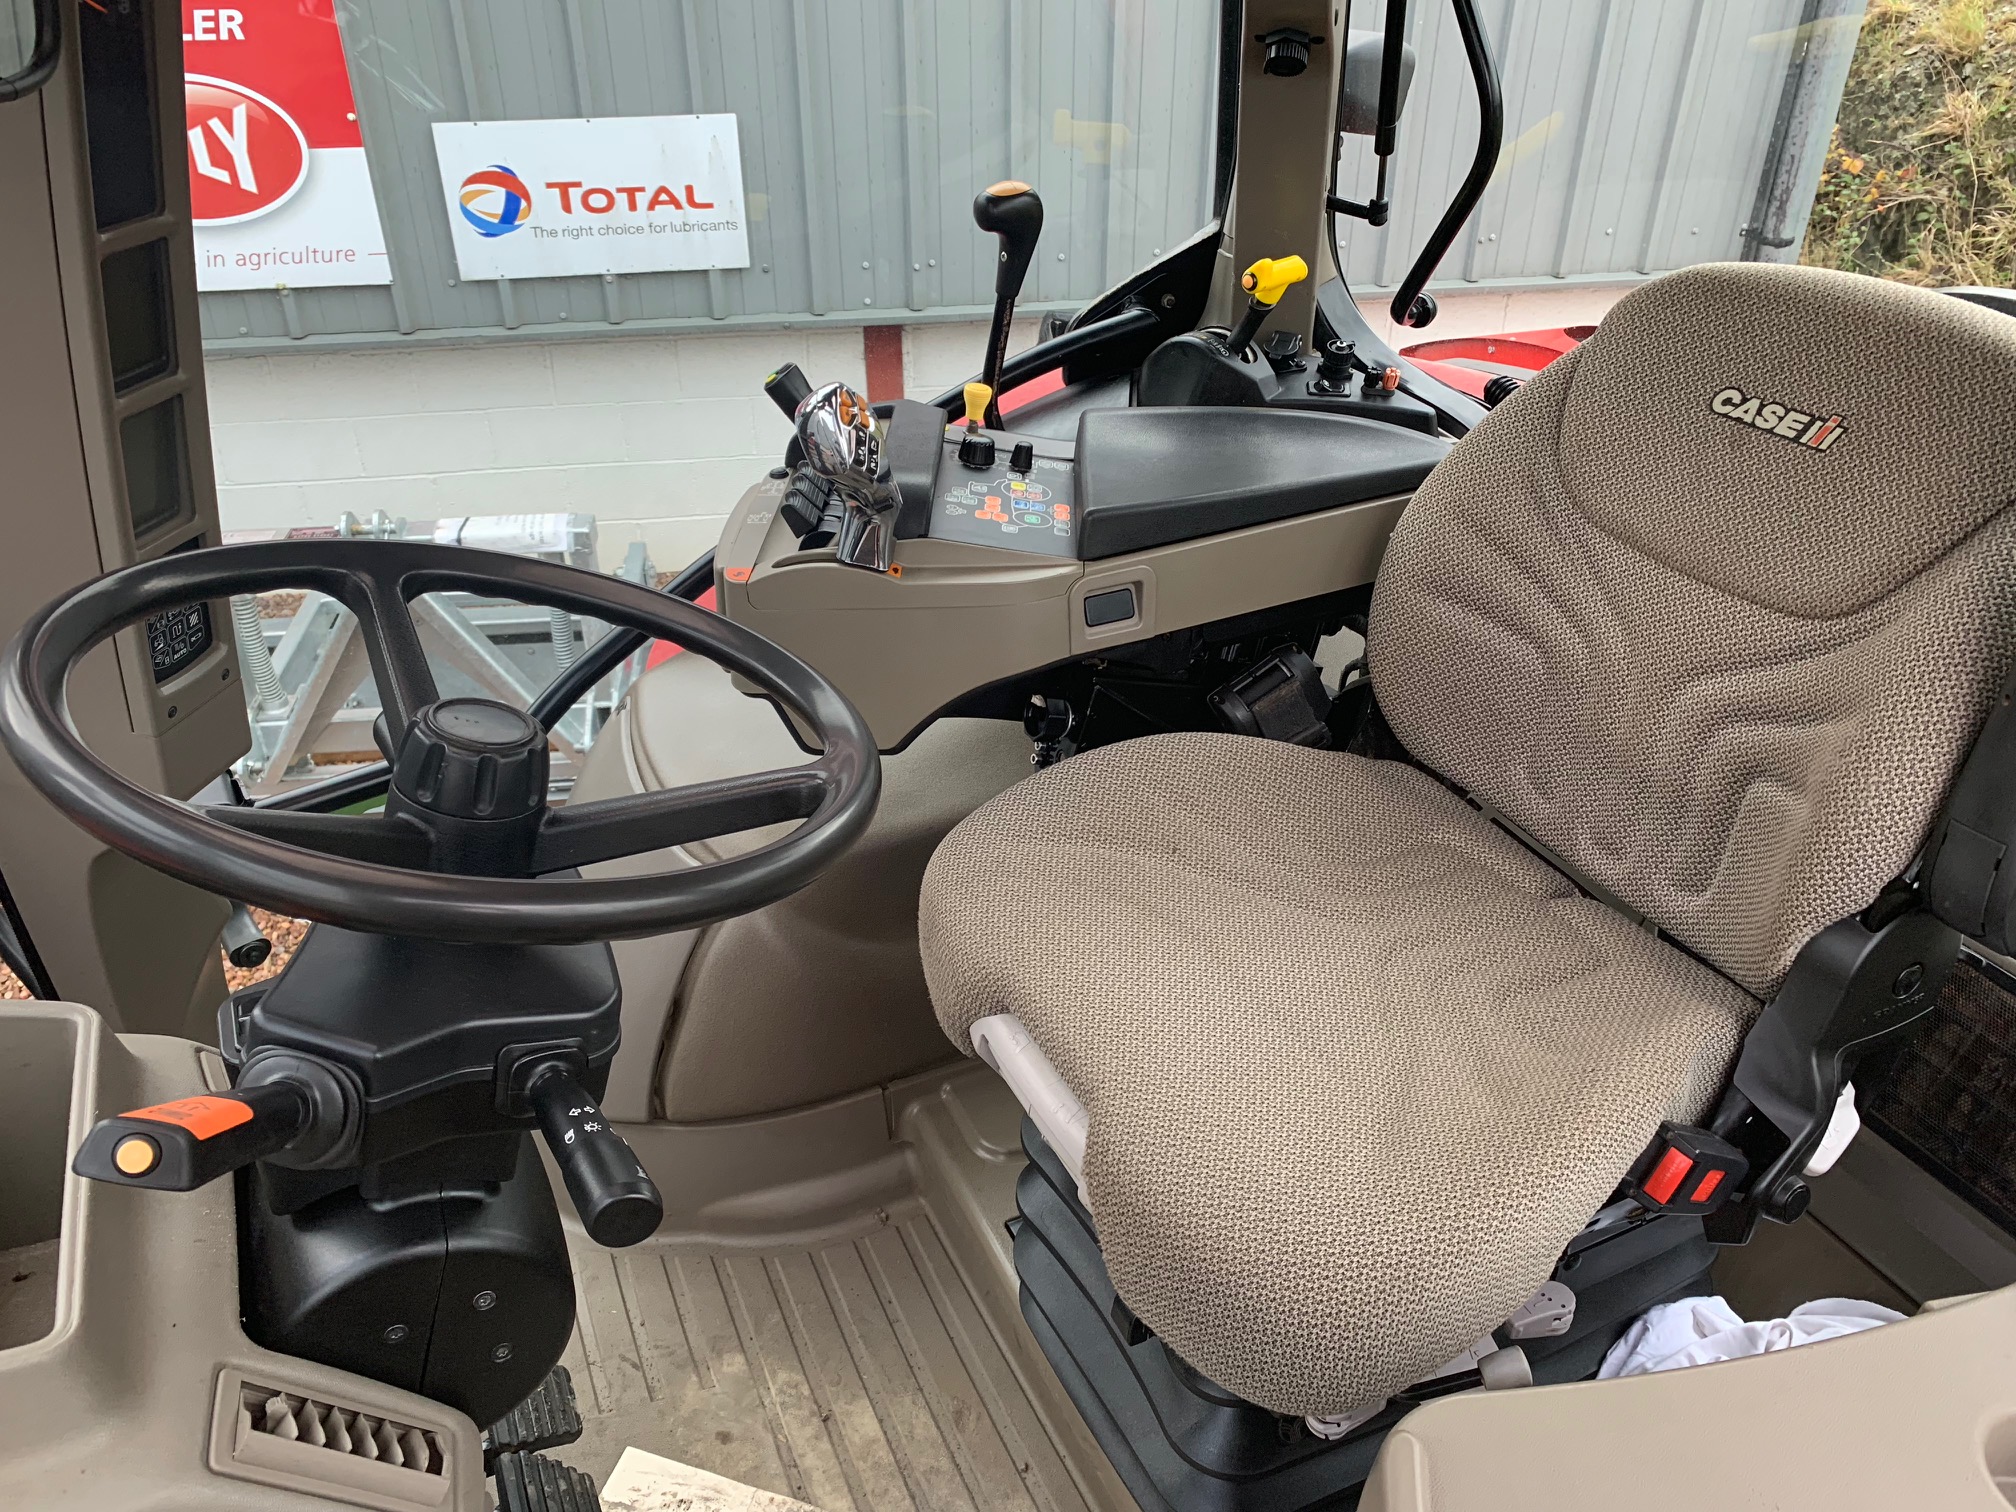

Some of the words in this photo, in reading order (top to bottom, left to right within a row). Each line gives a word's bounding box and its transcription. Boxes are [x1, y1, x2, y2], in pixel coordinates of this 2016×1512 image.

[530, 226, 559, 239] The
[562, 225, 595, 240] right
[598, 222, 645, 237] choice
[648, 221, 669, 235] for
[670, 219, 739, 234] lubricants
[206, 249, 226, 268] in
[235, 246, 356, 271] agriculture
